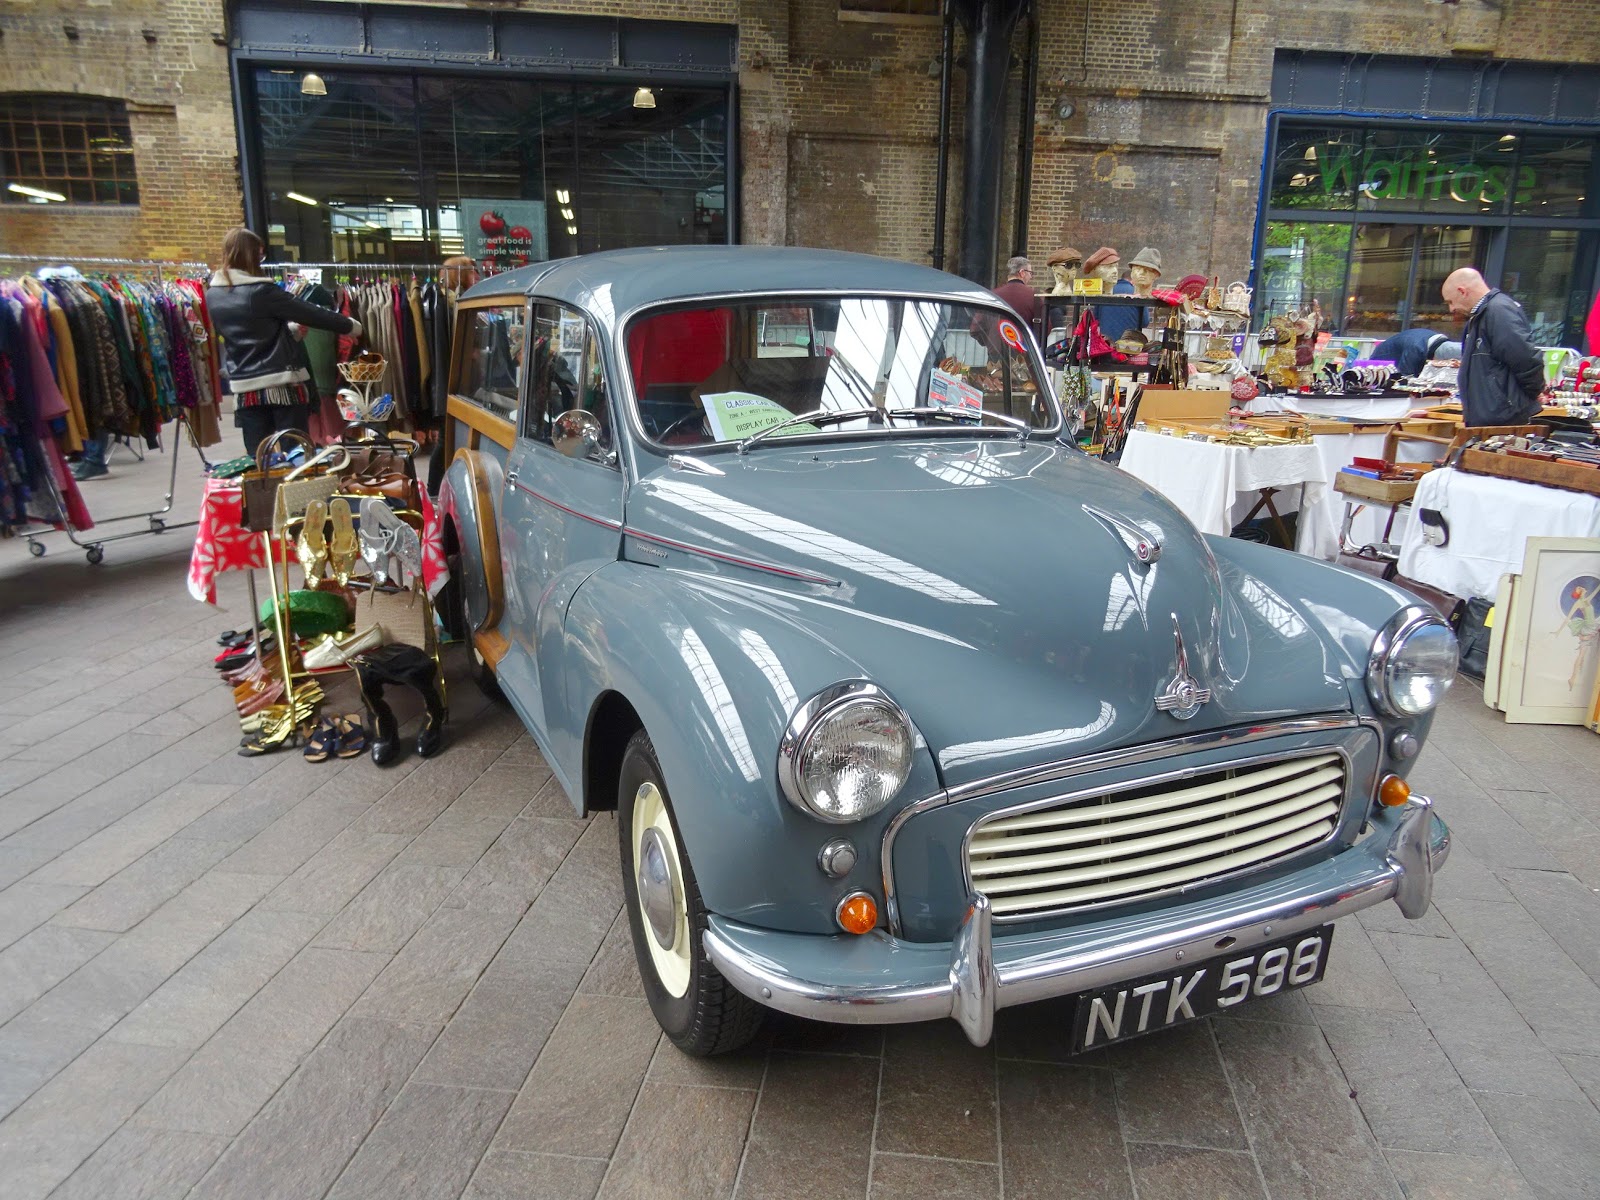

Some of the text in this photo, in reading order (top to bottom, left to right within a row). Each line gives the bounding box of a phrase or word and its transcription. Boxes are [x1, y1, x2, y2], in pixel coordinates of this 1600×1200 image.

[1315, 144, 1537, 203] Waitrose
[477, 236, 532, 246] great food is
[479, 247, 532, 256] simple when
[725, 399, 755, 409] CLASSIC
[736, 416, 780, 432] DISPLAY CAR
[1084, 936, 1323, 1047] NTK 588
